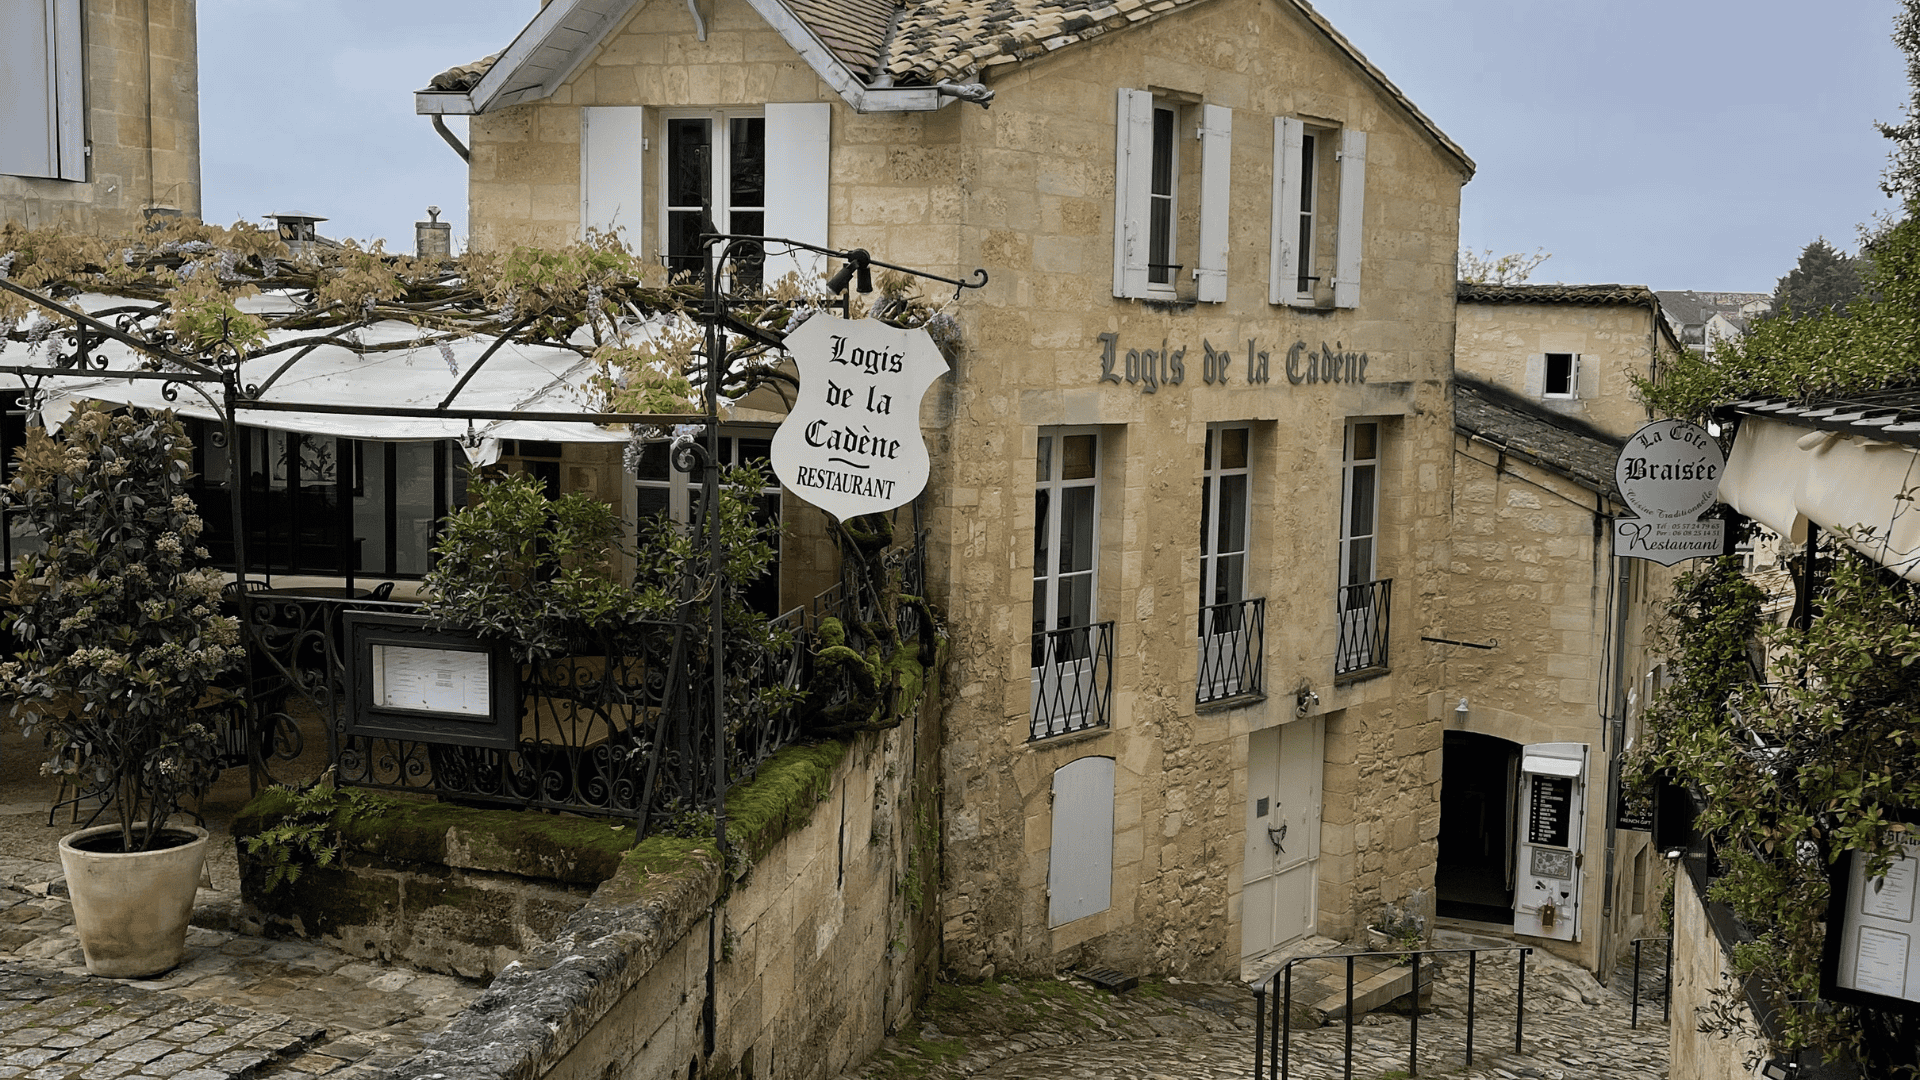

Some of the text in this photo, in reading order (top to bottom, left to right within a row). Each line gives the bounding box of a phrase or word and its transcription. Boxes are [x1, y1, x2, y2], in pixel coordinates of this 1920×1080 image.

[829, 335, 905, 375] Logis
[1097, 332, 1369, 394] Logis de la Cadène
[826, 379, 892, 415] de la
[804, 419, 900, 460] Cadène
[1636, 425, 1707, 450] La Côte
[796, 466, 895, 500] RESTAURANT
[1624, 457, 1717, 484] Braisée
[1626, 488, 1714, 519] Cuisine Traditionnelle
[1618, 523, 1719, 550] Restaurant
